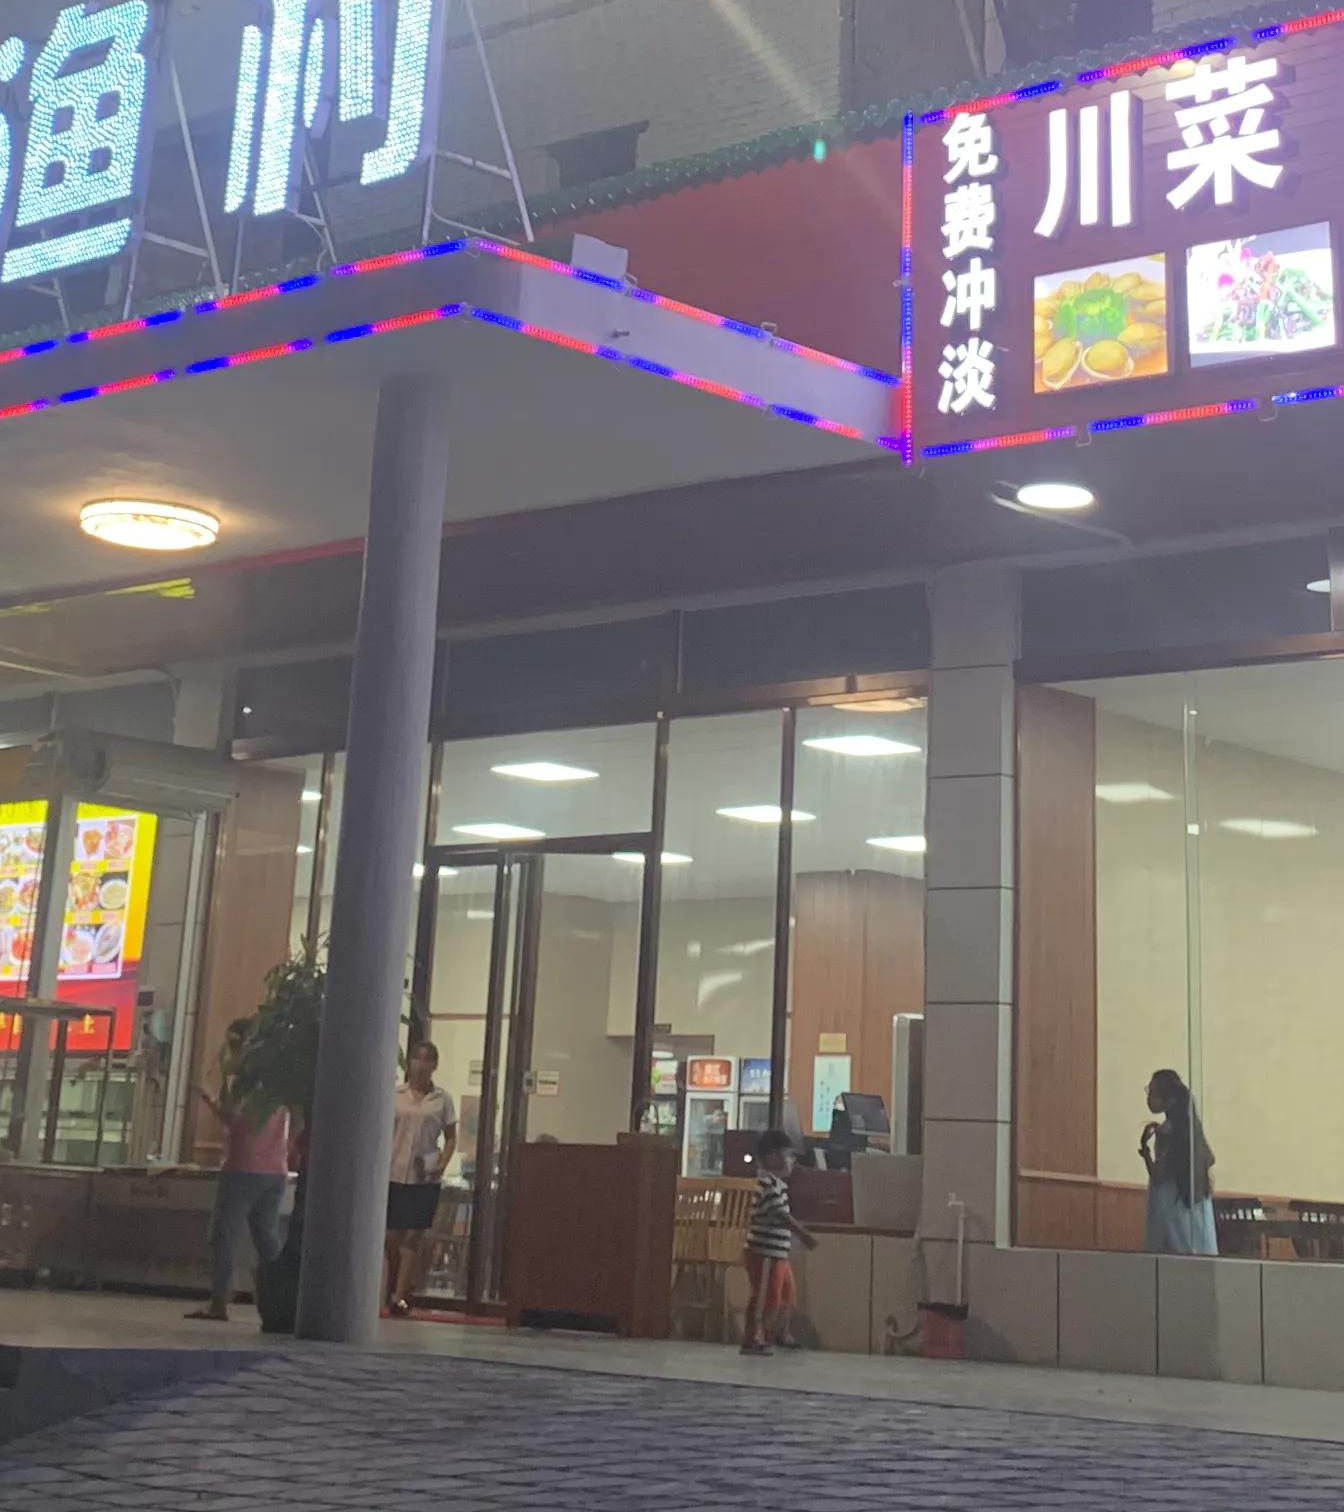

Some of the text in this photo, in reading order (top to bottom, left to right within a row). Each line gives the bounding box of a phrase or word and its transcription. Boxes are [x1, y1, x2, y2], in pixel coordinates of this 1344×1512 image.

[937, 112, 999, 415] 免费冲淡
[1034, 55, 1284, 238] 川菜
